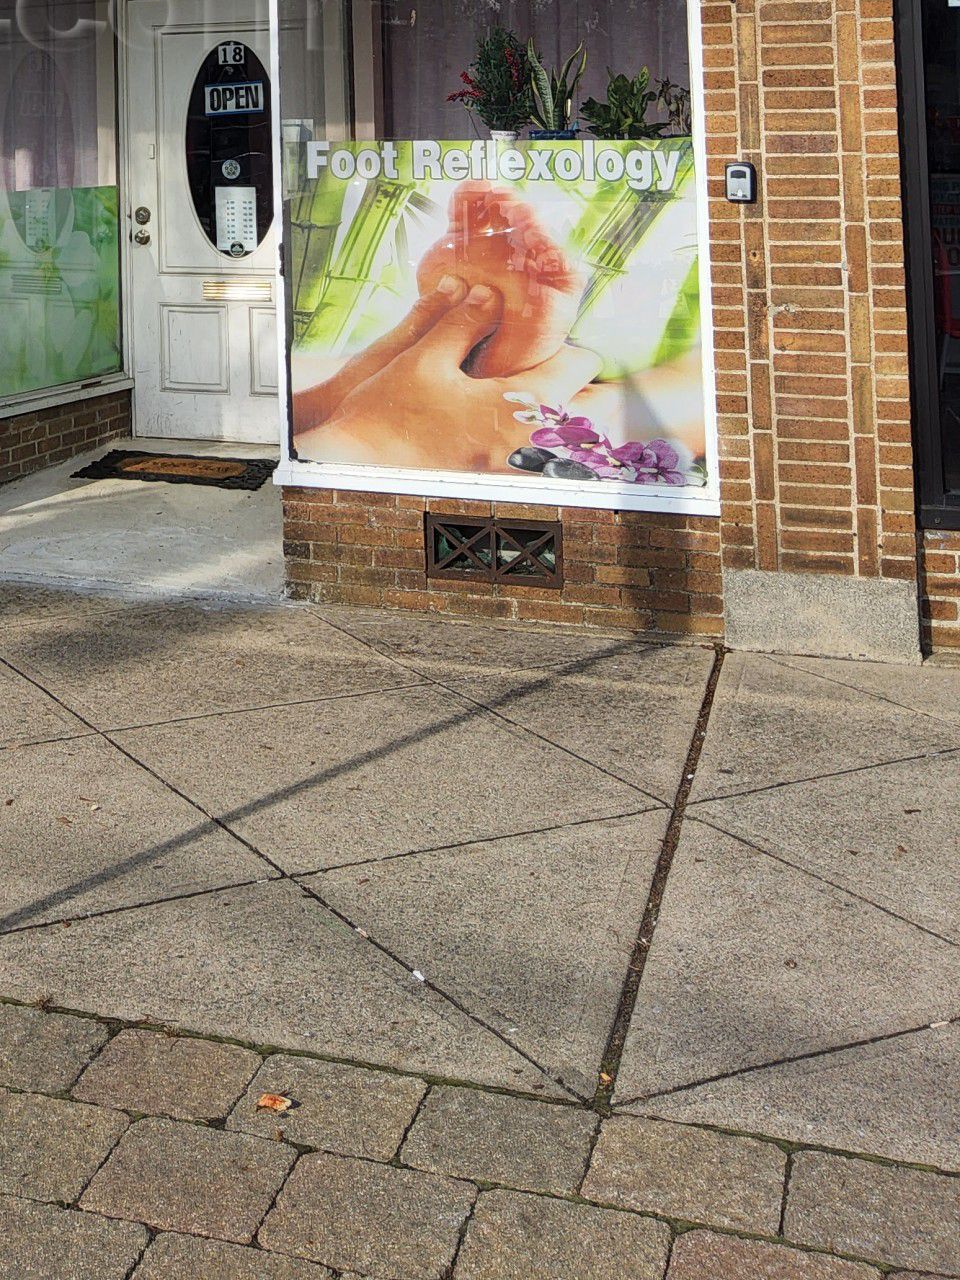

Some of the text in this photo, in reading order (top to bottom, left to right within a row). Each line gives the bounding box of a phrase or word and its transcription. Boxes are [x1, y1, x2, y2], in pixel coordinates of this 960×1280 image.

[221, 46, 244, 63] 18
[209, 84, 260, 112] OPEN
[306, 139, 681, 193] Foot Reflexology
